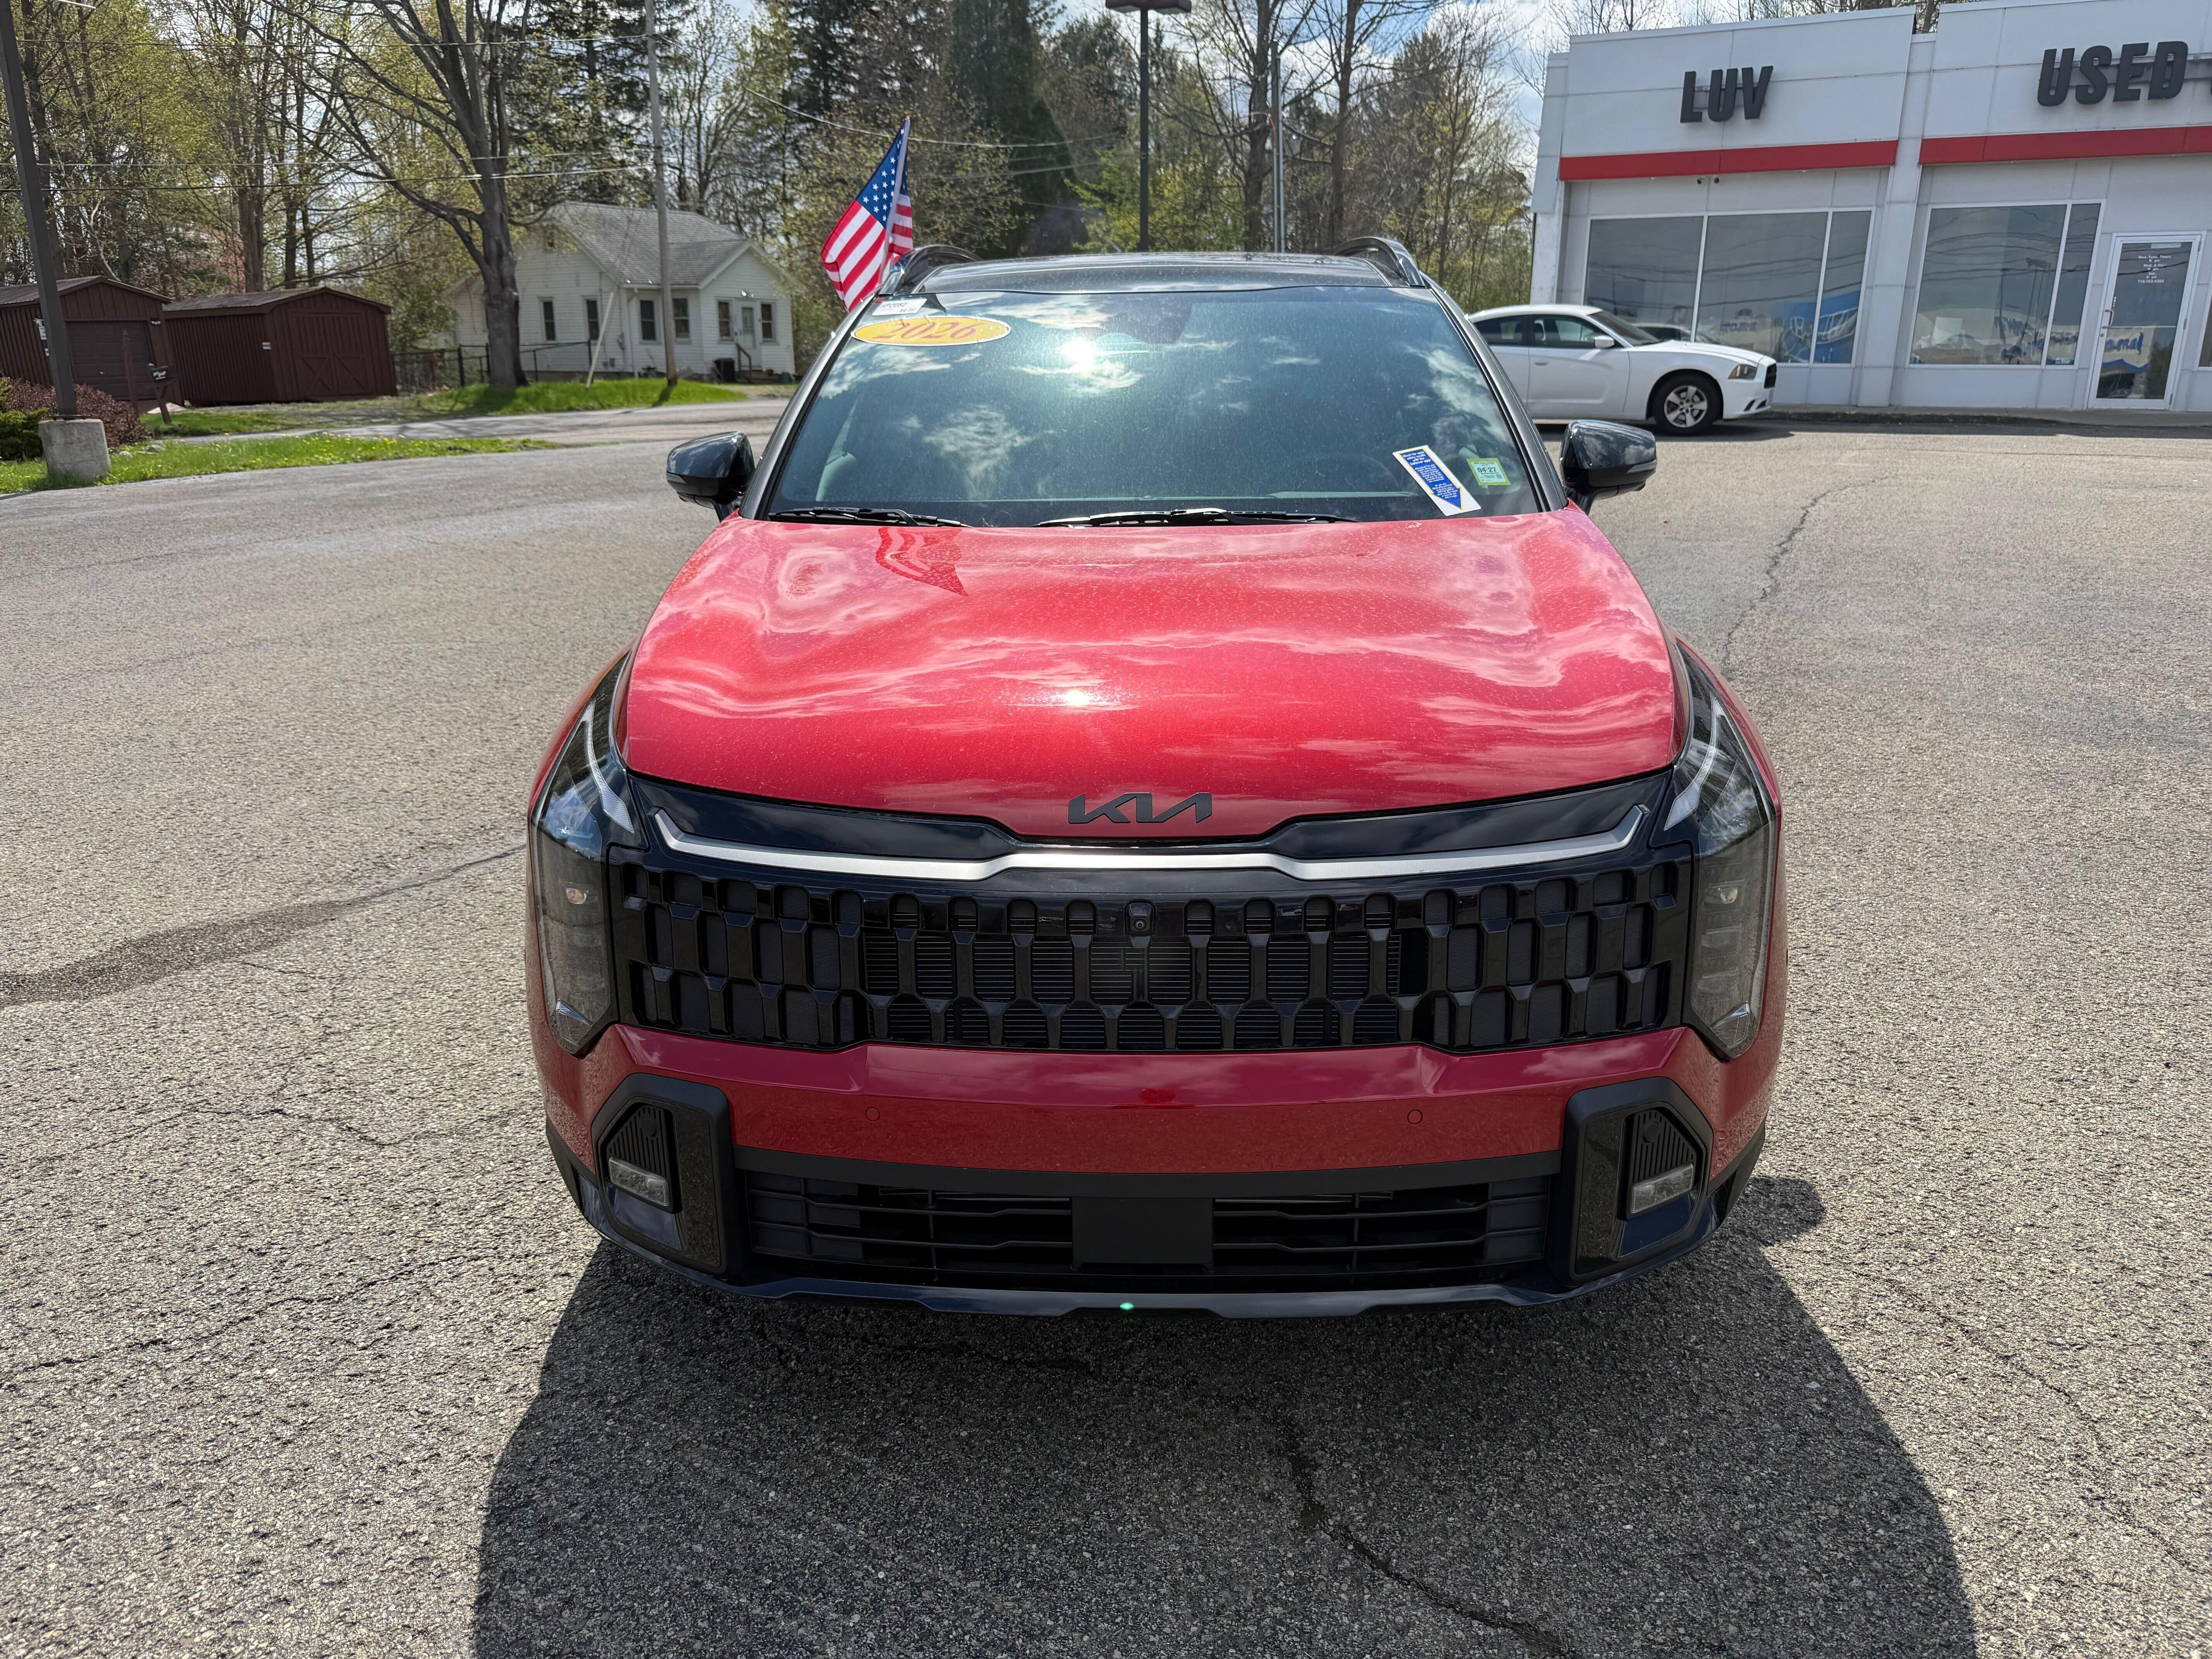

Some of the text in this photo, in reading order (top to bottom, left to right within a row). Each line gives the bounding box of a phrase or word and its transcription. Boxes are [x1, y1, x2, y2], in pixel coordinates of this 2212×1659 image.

[1680, 65, 1773, 123] LUV
[2037, 41, 2188, 106] USED
[871, 322, 982, 339] 2026
[1068, 792, 1212, 824] KIA
